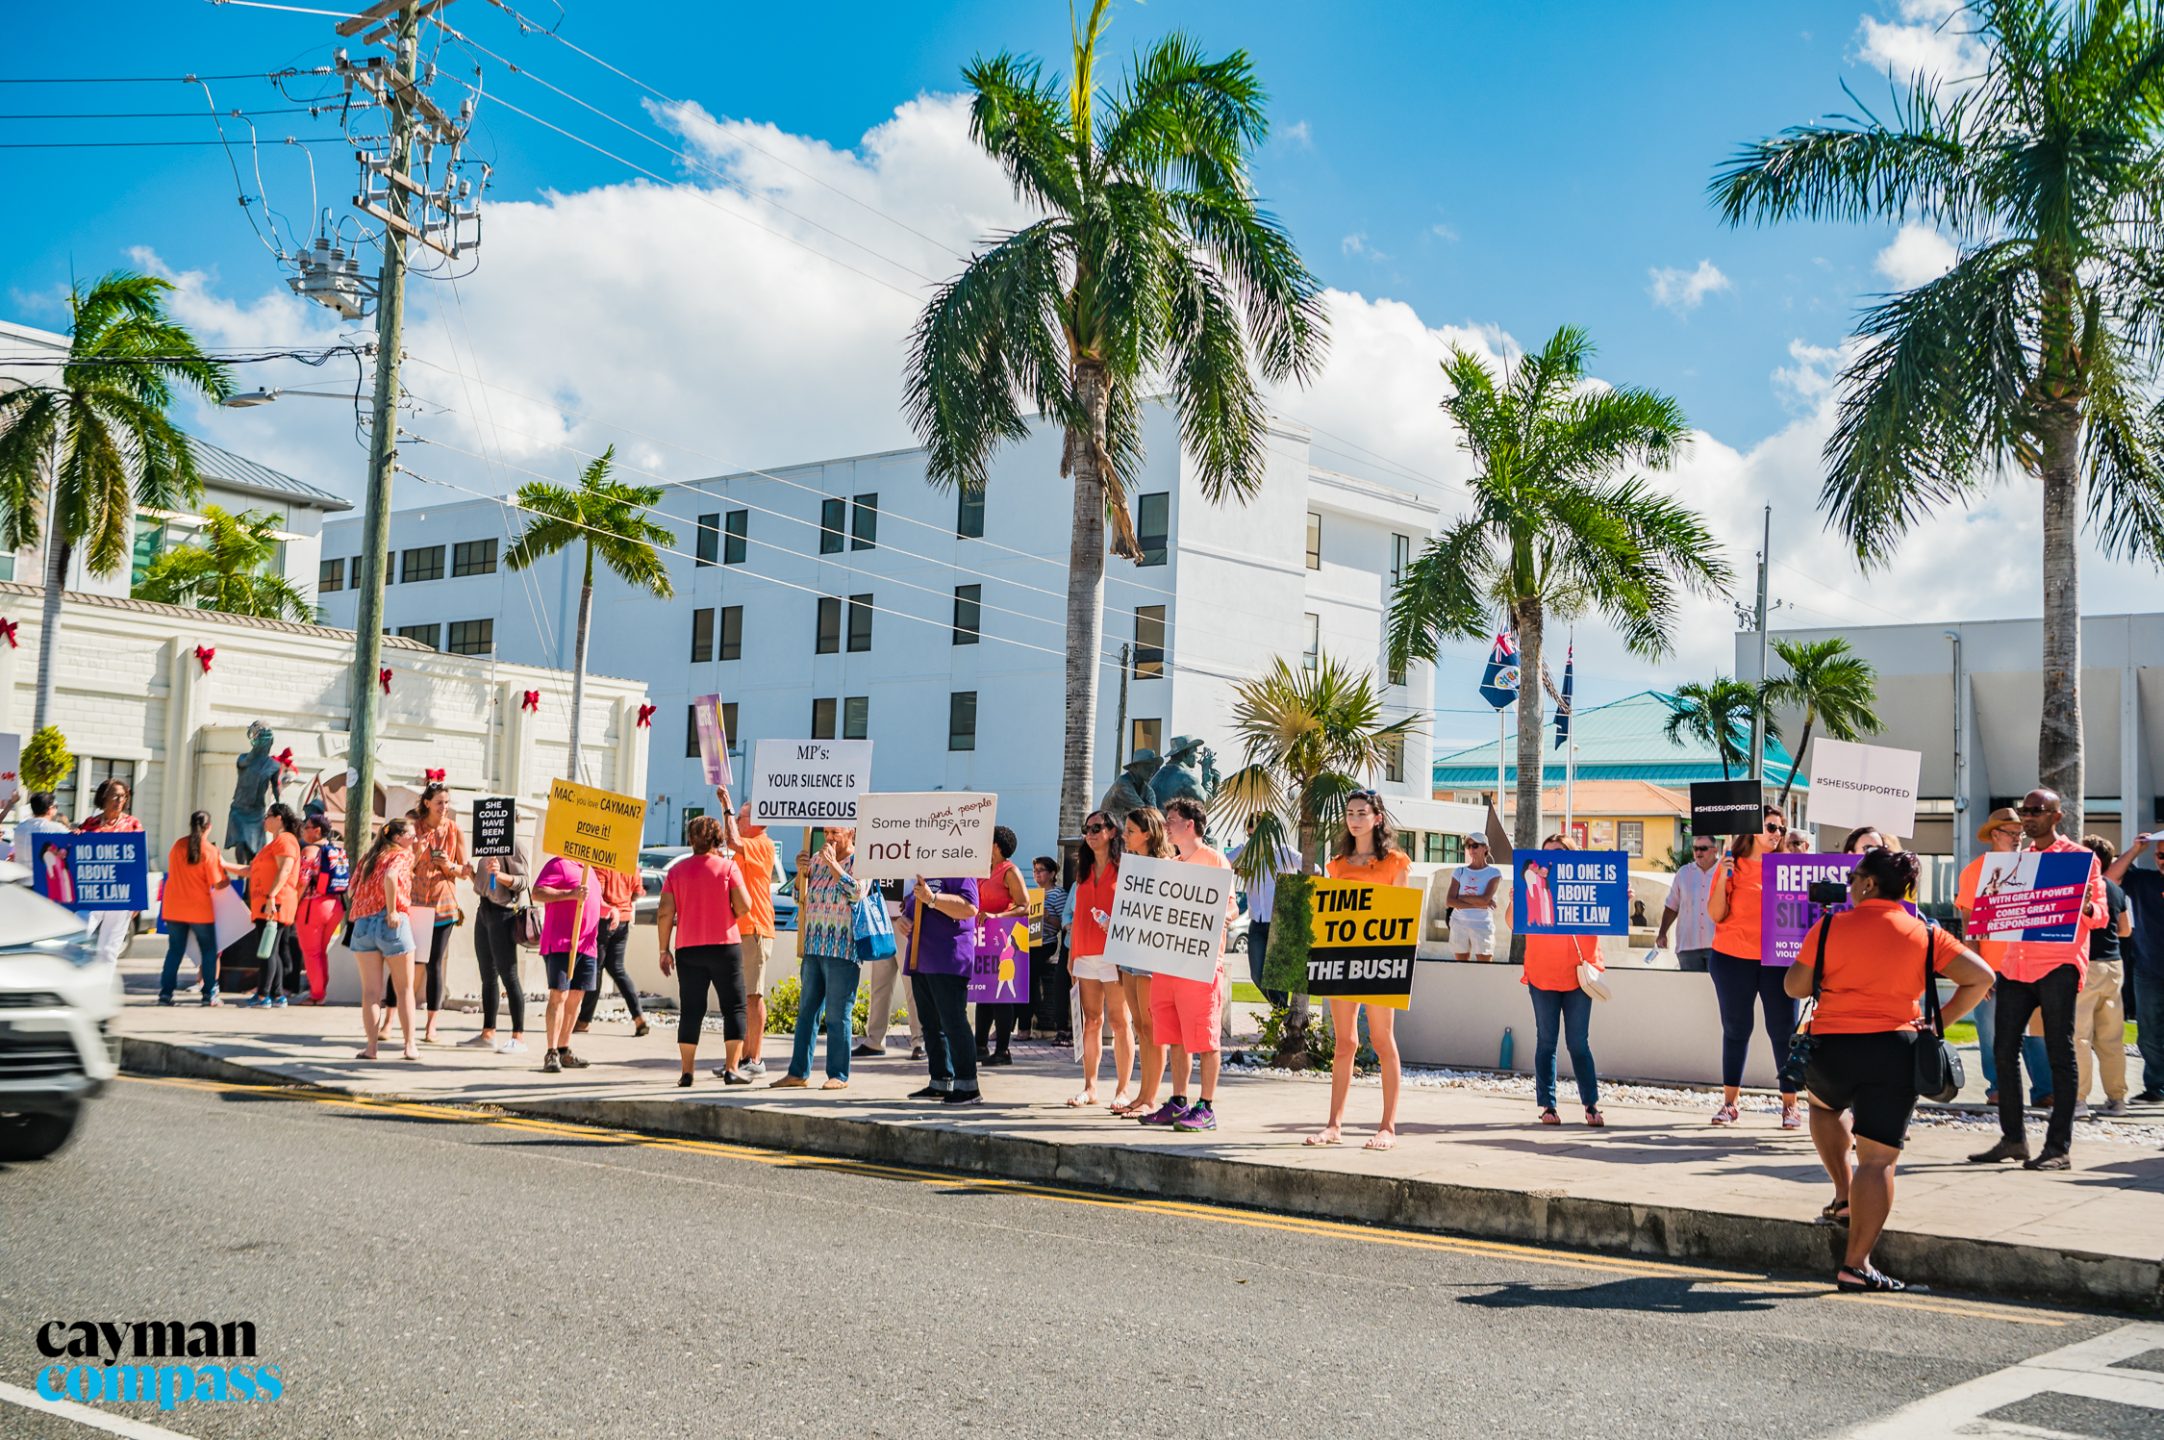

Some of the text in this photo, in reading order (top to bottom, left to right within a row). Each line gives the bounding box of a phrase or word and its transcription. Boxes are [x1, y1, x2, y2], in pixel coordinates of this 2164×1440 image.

[796, 745, 829, 760] MP's:
[768, 774, 855, 788] YOUR SILENCE IS
[1816, 777, 1910, 798] #SHEISSUPPORTED
[485, 801, 502, 809] SHE
[554, 787, 576, 802] MAC:
[600, 798, 641, 819] CAYMAN?
[758, 801, 856, 816] OUTRAGEOUS
[929, 798, 992, 820] and people
[1694, 804, 1759, 812] #SHEISSUPPORTED
[479, 810, 508, 818] COULD
[482, 819, 504, 827] HAVE
[577, 821, 611, 837] prove it!
[872, 818, 980, 830] Some things are
[482, 828, 504, 836] BEEN
[76, 844, 135, 860] NO ONE IS
[475, 846, 510, 855] MOTHER
[564, 841, 617, 865] RETIRE NOW!
[869, 839, 978, 860] not for sale.
[77, 865, 116, 879] ABOVE
[1557, 864, 1616, 880] NO ONE IS
[77, 884, 130, 899] THE LAW
[1124, 875, 1219, 905] SHE COULD
[1557, 885, 1597, 901] ABOVE
[1988, 887, 2074, 905] WITH GREAT POWER
[1316, 888, 1374, 912] TIME
[1030, 902, 1042, 915] UT
[1120, 900, 1214, 931] HAVE BEEN
[1557, 906, 1610, 923] THE LAW
[1995, 903, 2056, 918] COMES GREAT
[1325, 918, 1414, 942] TO CUT
[1987, 914, 2065, 931] RESPONSIBILITY
[1111, 924, 1210, 958] MY MOTHER
[1776, 941, 1787, 949] NO
[1307, 959, 1408, 980] THE BUSH
